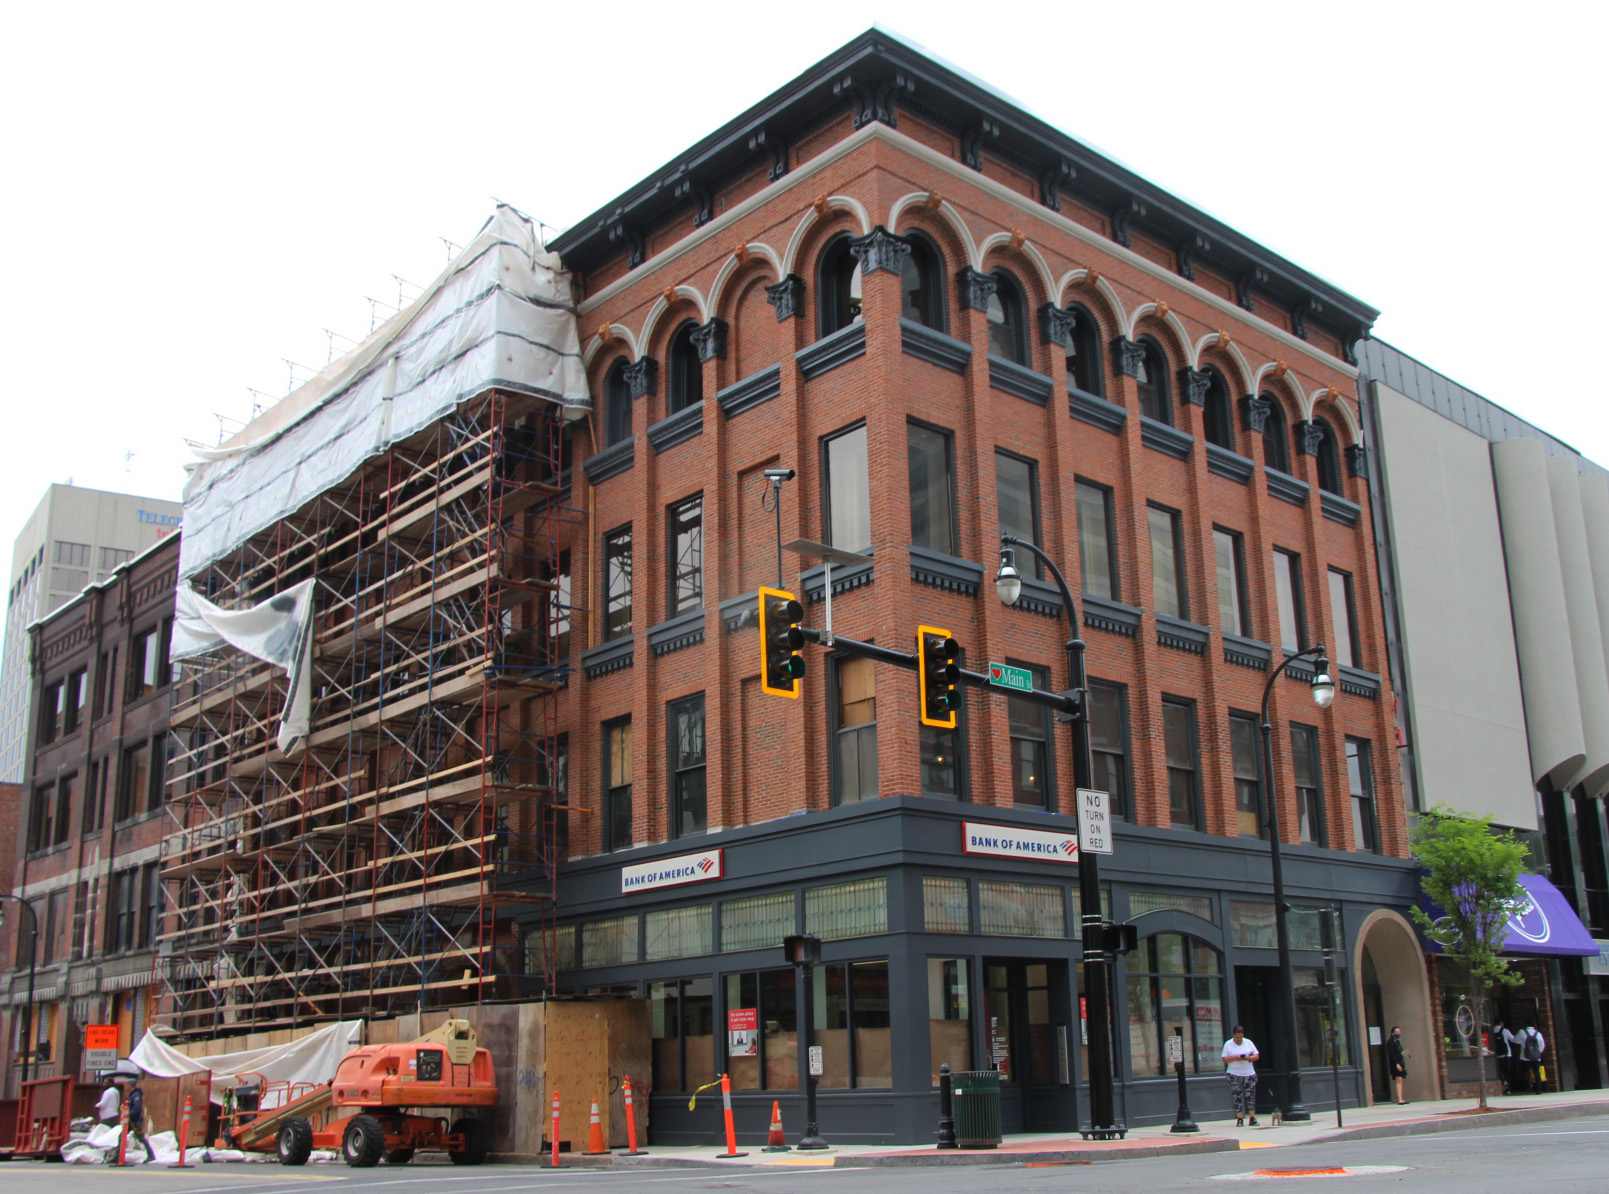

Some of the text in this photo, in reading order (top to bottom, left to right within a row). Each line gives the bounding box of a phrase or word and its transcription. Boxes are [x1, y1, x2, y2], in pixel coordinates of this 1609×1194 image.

[1001, 668, 1024, 688] Main
[1086, 795, 1100, 807] NO
[1085, 810, 1104, 821] TURN
[1090, 824, 1101, 834] ON
[971, 836, 1059, 854] BANK OF AMERICA
[1089, 838, 1104, 849] RED
[624, 866, 696, 887] BANK OF AMERICA
